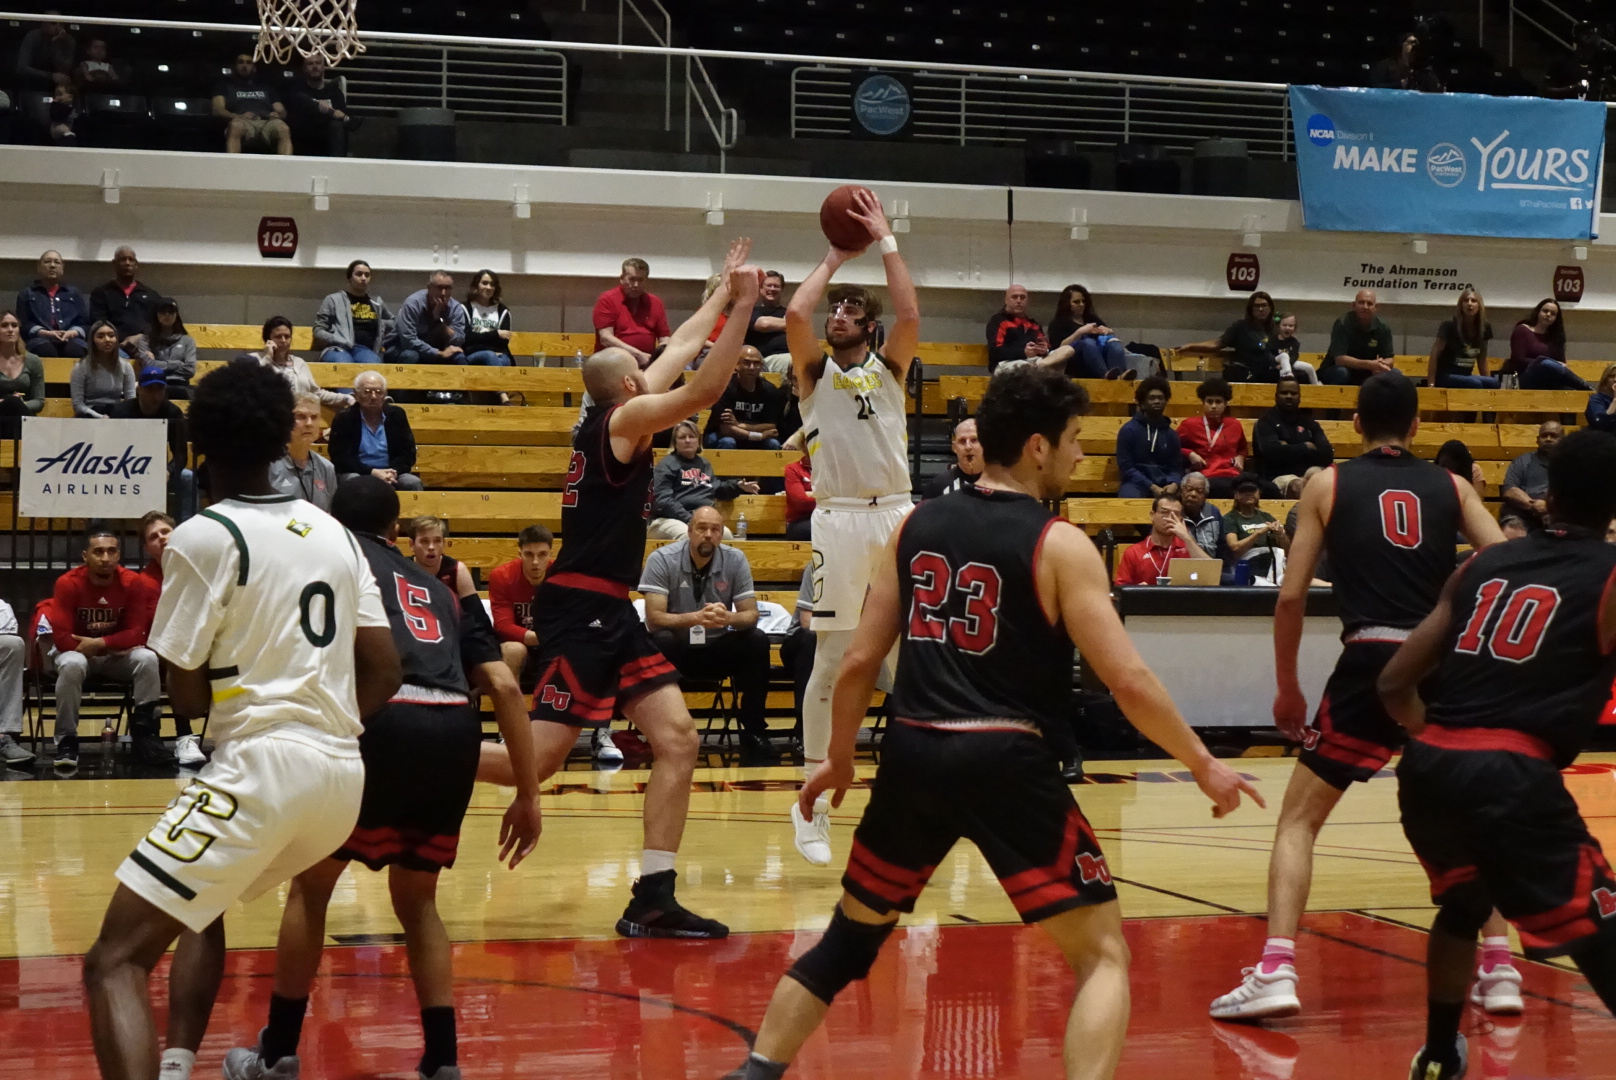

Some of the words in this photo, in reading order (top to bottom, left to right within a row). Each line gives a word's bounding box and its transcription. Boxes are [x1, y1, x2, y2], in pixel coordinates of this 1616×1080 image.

[1309, 128, 1335, 140] NCAA
[1333, 145, 1418, 173] MAKE
[262, 231, 294, 247] 102
[1230, 266, 1257, 281] 103
[1360, 263, 1385, 274] The
[1389, 264, 1458, 277] Ahmanson
[1343, 276, 1418, 289] Foundation
[1423, 279, 1473, 291] Terrace
[1556, 278, 1581, 292] 103
[35, 442, 152, 479] Alaska
[42, 483, 141, 495] AIRLINES
[1379, 489, 1423, 549] 0
[299, 580, 336, 648] 0
[393, 571, 444, 644] 5
[907, 550, 1002, 656] 23
[1455, 578, 1562, 664] 10
